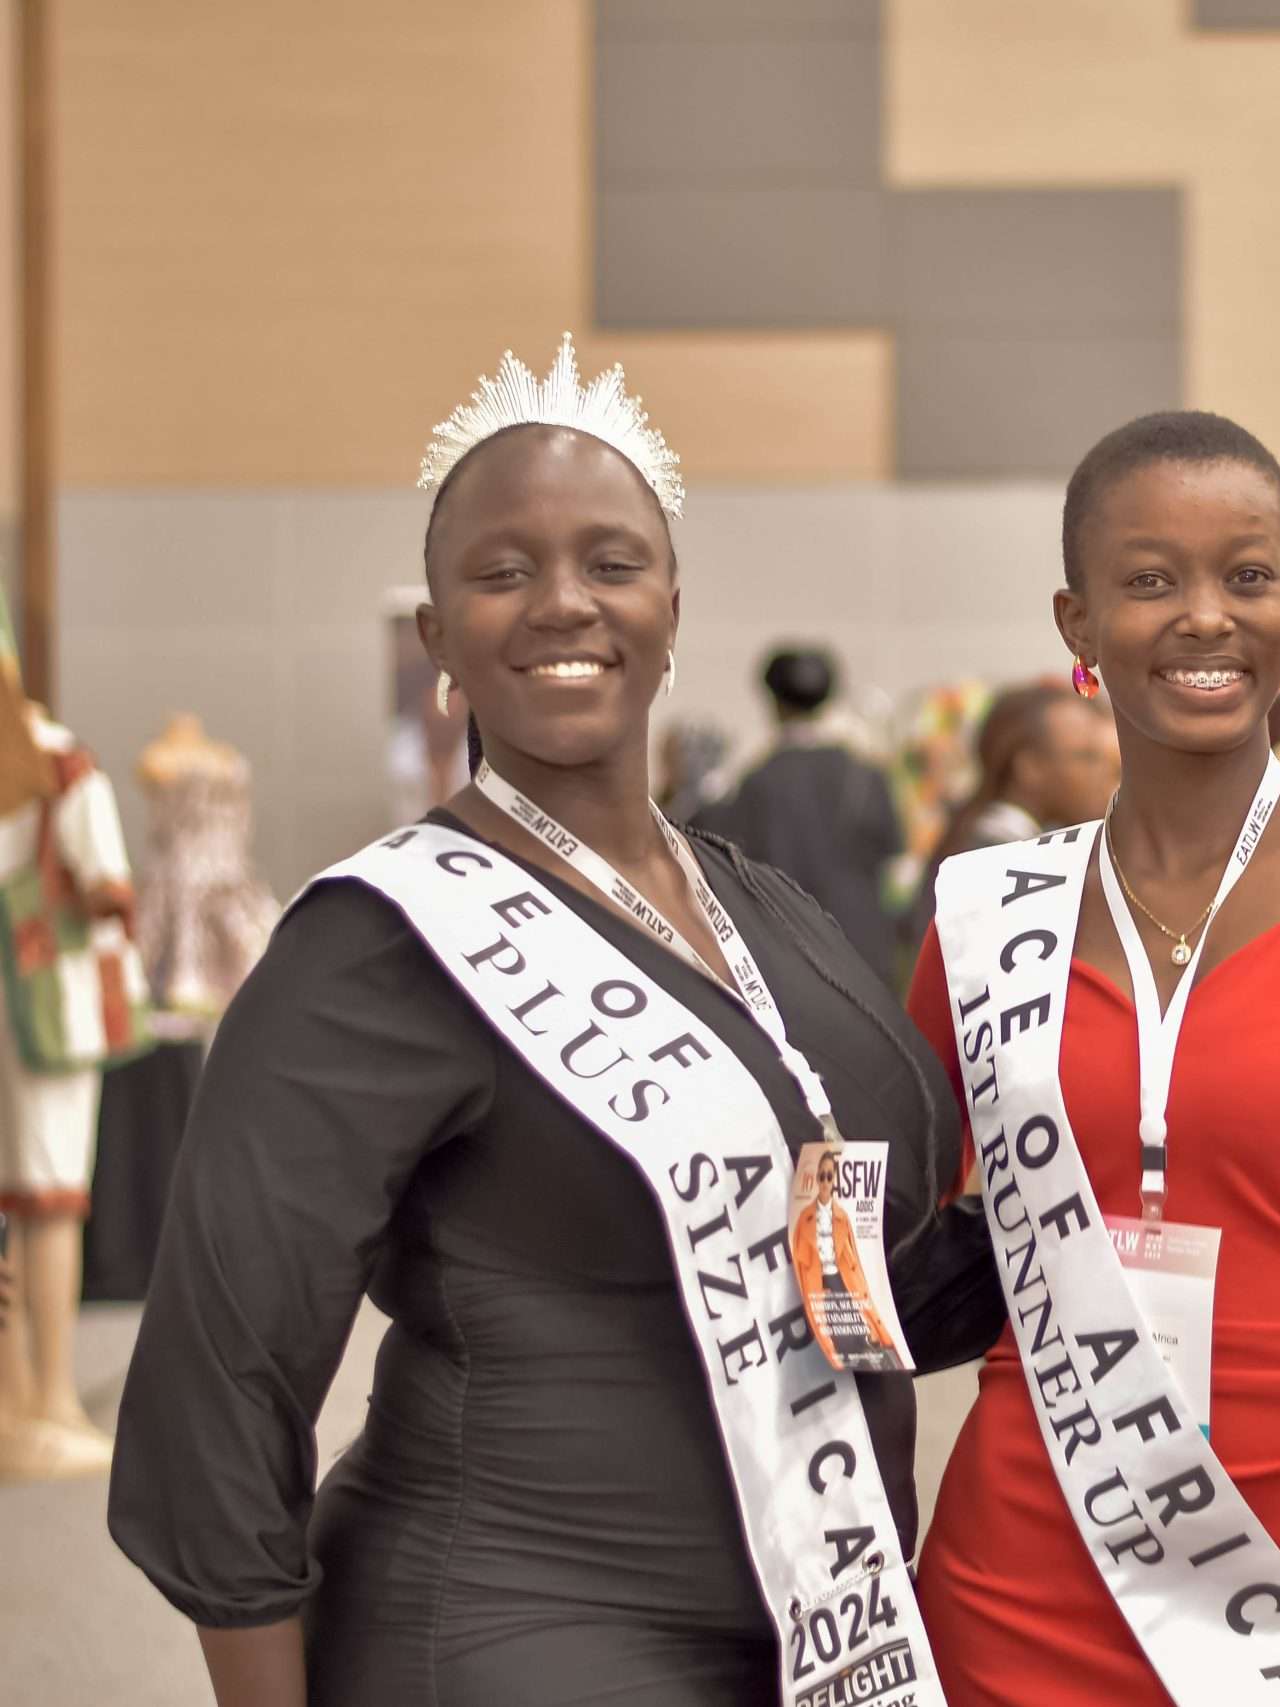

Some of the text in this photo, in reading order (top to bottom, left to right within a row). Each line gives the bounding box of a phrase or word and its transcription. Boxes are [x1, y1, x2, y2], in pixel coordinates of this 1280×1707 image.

[530, 815, 578, 857] EATLW
[1236, 819, 1261, 866] EATLW
[632, 901, 674, 943] EATLW
[705, 900, 734, 943] EATLW
[461, 931, 769, 1387] PLUS SIZE
[831, 1160, 882, 1198] ASFW
[1015, 1114, 1092, 1240] OF
[856, 1200, 874, 1212] ADDIS
[591, 979, 712, 1069] OF
[722, 1153, 877, 1581] AFRICA
[980, 1123, 1103, 1466] RUNNER
[1083, 1466, 1166, 1567] UP
[790, 1576, 898, 1682] 2024
